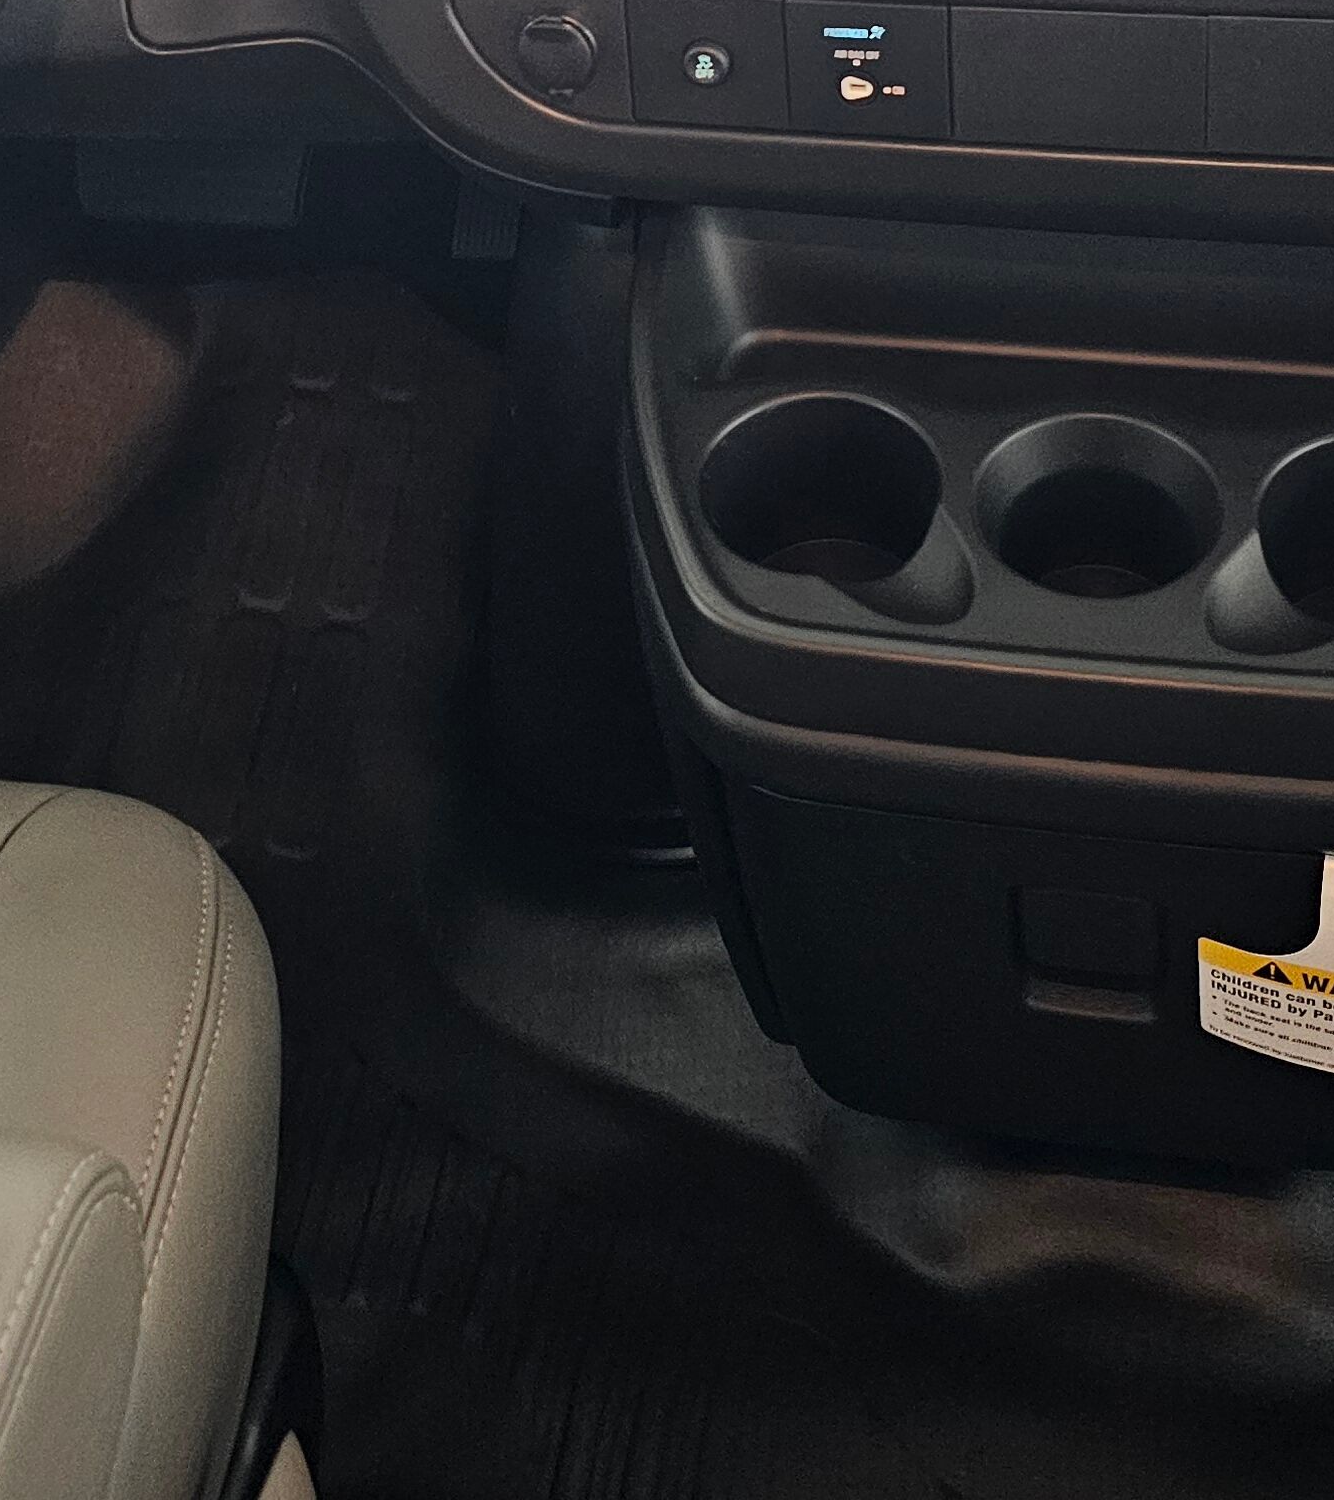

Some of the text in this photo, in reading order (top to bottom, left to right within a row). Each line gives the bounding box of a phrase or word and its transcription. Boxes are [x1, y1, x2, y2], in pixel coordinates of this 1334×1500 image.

[1210, 969, 1280, 997] Children
[1285, 993, 1316, 1006] can
[1211, 980, 1281, 1009] INJURED
[1287, 1004, 1307, 1017] by
